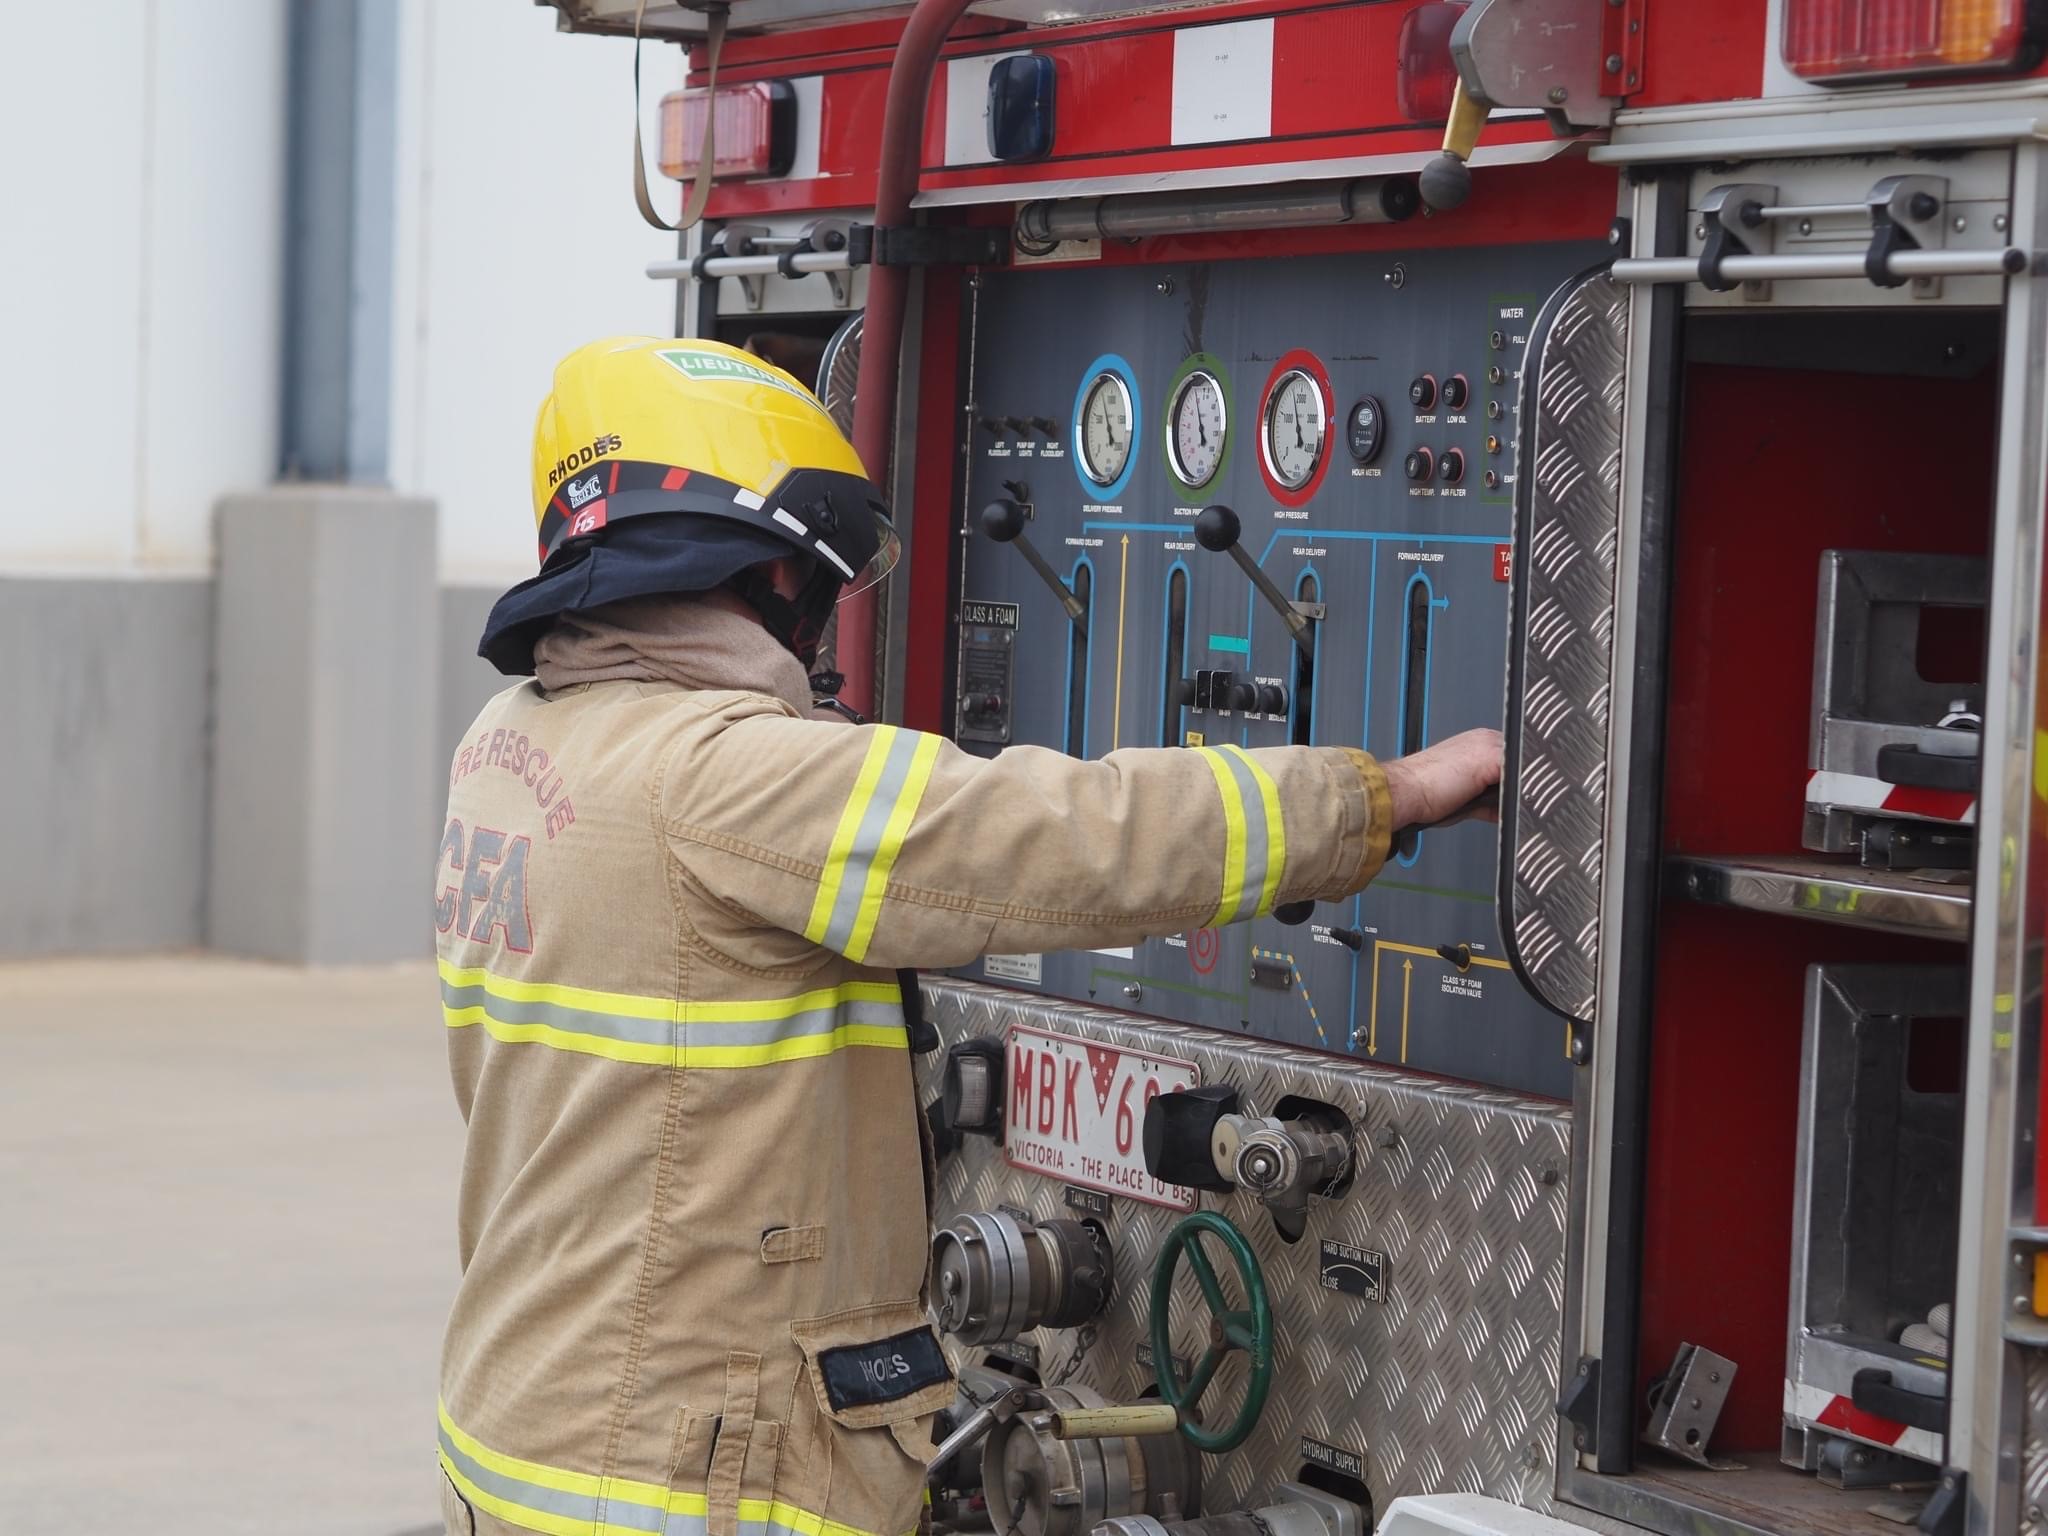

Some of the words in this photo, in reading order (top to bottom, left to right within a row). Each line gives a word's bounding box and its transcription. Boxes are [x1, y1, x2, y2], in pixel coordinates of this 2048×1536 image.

[1500, 308, 1525, 319] WATER
[1512, 335, 1526, 344] FULL
[1415, 415, 1437, 424] BATTERY
[1447, 415, 1458, 424] LOW
[1458, 416, 1468, 424] OIL
[548, 433, 622, 488] RHODES
[1351, 468, 1365, 477] HOUR
[1365, 469, 1382, 477] METER
[1503, 474, 1515, 483] EMP
[1440, 488, 1450, 497] AIR
[1450, 488, 1466, 497] FILTER
[1173, 507, 1192, 516] SUCTION
[1274, 511, 1286, 519] HIGH
[1286, 511, 1309, 520] PRESSURE
[1164, 542, 1176, 550] REAR
[1292, 547, 1305, 556] REAR
[1305, 548, 1327, 557] DELIVERY
[1397, 551, 1420, 561] FORWARD
[1420, 553, 1444, 562] DELIVERY
[964, 606, 986, 622] CLASS
[987, 607, 994, 623] A
[995, 608, 1016, 626] FOAM
[486, 728, 576, 840] RESCUE
[434, 817, 534, 955] CFA
[1313, 934, 1329, 944] WATER
[1442, 975, 1459, 986] CLASS
[1467, 978, 1482, 989] FOAM
[1441, 984, 1466, 997] ISOLATION
[1466, 987, 1482, 999] VALVE
[1012, 1045, 1083, 1146] MBK
[1014, 1138, 1065, 1171] VICTORIA
[1081, 1156, 1102, 1179] THE
[1108, 1163, 1143, 1191] PLACE
[1323, 1241, 1338, 1256] HARD
[1339, 1245, 1362, 1262] SUCTION
[1363, 1251, 1380, 1268] VALVE
[1321, 1275, 1339, 1290] CLOSE
[1364, 1286, 1379, 1301] OPEN
[1302, 1439, 1333, 1465] HYDRANT
[1335, 1451, 1361, 1475] SUPPLY
